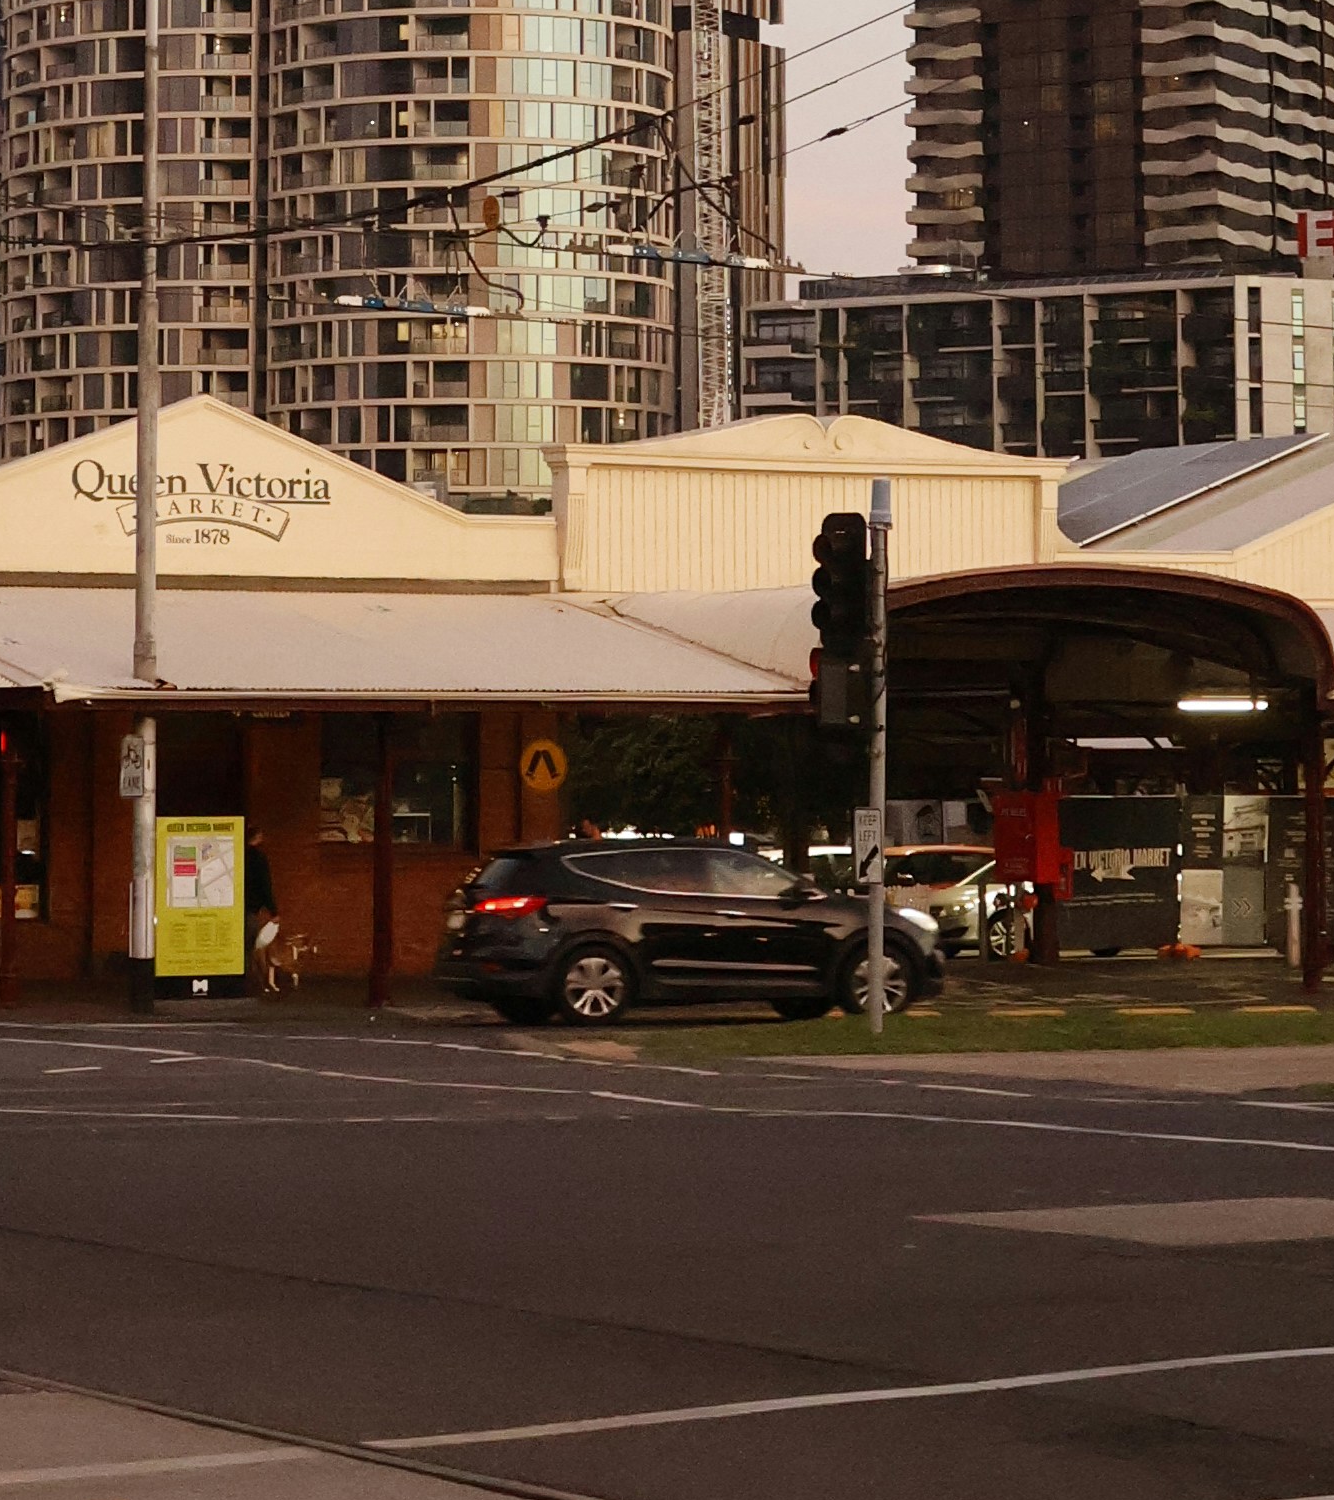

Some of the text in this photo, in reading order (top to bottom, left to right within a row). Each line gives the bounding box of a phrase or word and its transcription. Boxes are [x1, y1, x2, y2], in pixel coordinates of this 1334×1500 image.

[196, 463, 331, 500] Victoria
[155, 498, 265, 524] ARKET
[166, 528, 230, 545] Since 1878
[858, 830, 877, 842] LEFT
[1134, 848, 1172, 867] MARKET
